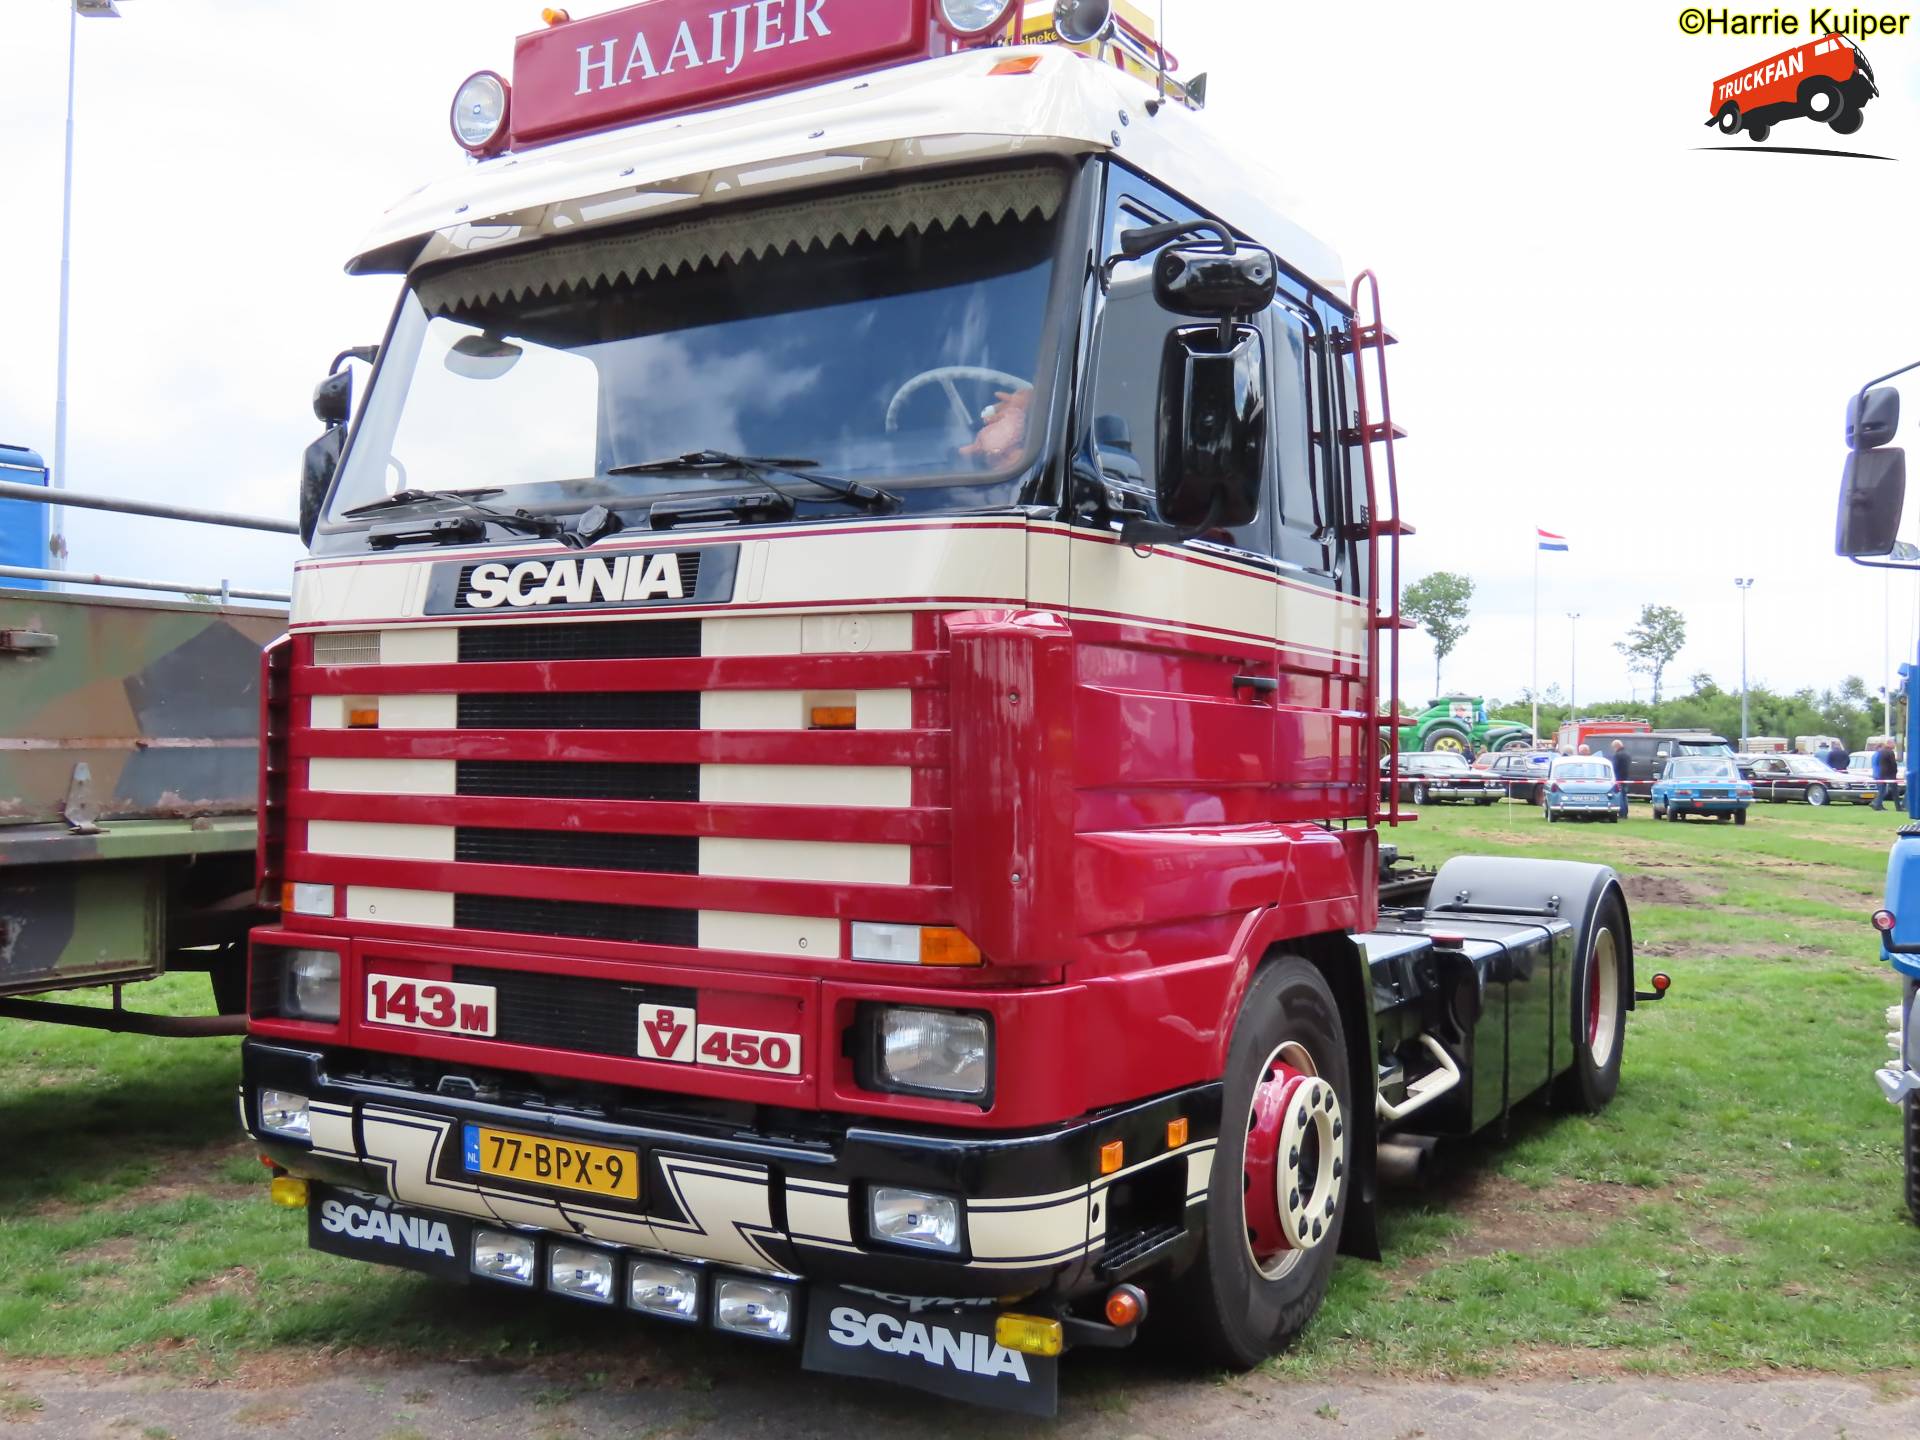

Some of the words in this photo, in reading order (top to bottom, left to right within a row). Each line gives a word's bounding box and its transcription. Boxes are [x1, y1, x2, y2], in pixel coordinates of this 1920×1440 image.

[574, 0, 832, 96] HAAIJER
[465, 552, 684, 608] SCANIA
[701, 1031, 791, 1069] 450
[467, 1151, 479, 1164] NL
[489, 1135, 624, 1189] 77-BPX-9
[321, 1199, 456, 1257] SCANIA
[828, 1306, 1032, 1383] SCANIA
